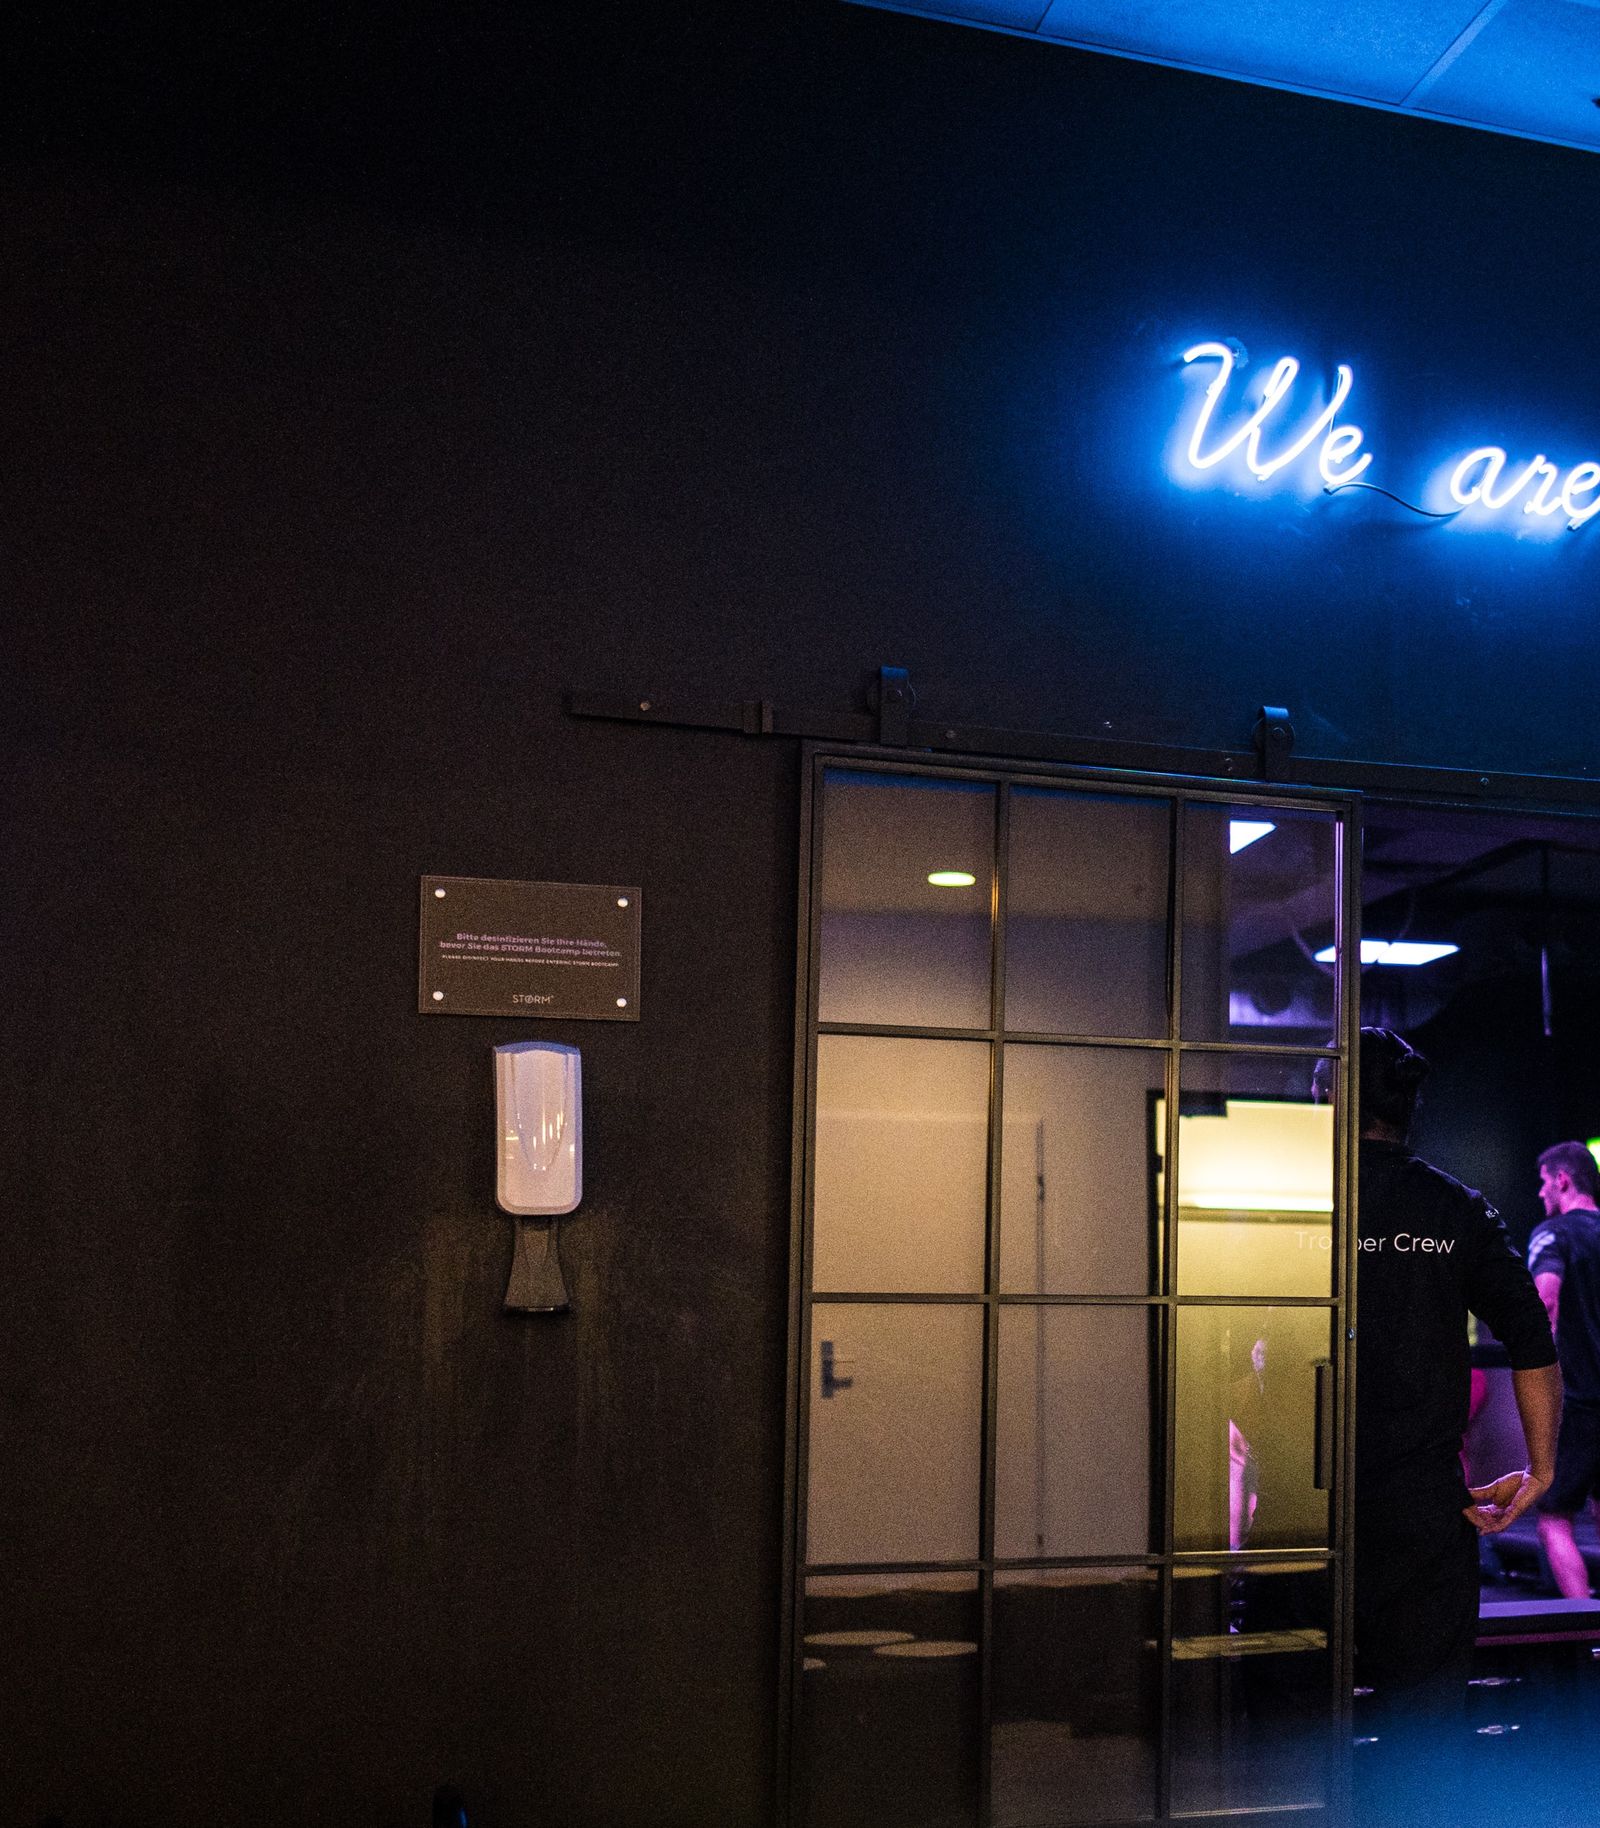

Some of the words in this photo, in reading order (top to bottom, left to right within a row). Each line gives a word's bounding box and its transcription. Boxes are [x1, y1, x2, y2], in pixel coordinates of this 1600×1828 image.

[1182, 341, 1374, 490] We
[439, 940, 465, 949] bevor
[467, 942, 482, 950] Sie
[483, 943, 499, 951] das
[501, 944, 533, 953] STORM
[535, 946, 581, 955] Bootcamp
[456, 932, 479, 942] Bitte
[480, 933, 540, 945] desinfizieren
[541, 936, 555, 945] Sie
[556, 938, 575, 946] Ihre
[1295, 1231, 1387, 1253] Troer
[1393, 1232, 1456, 1254] Crew
